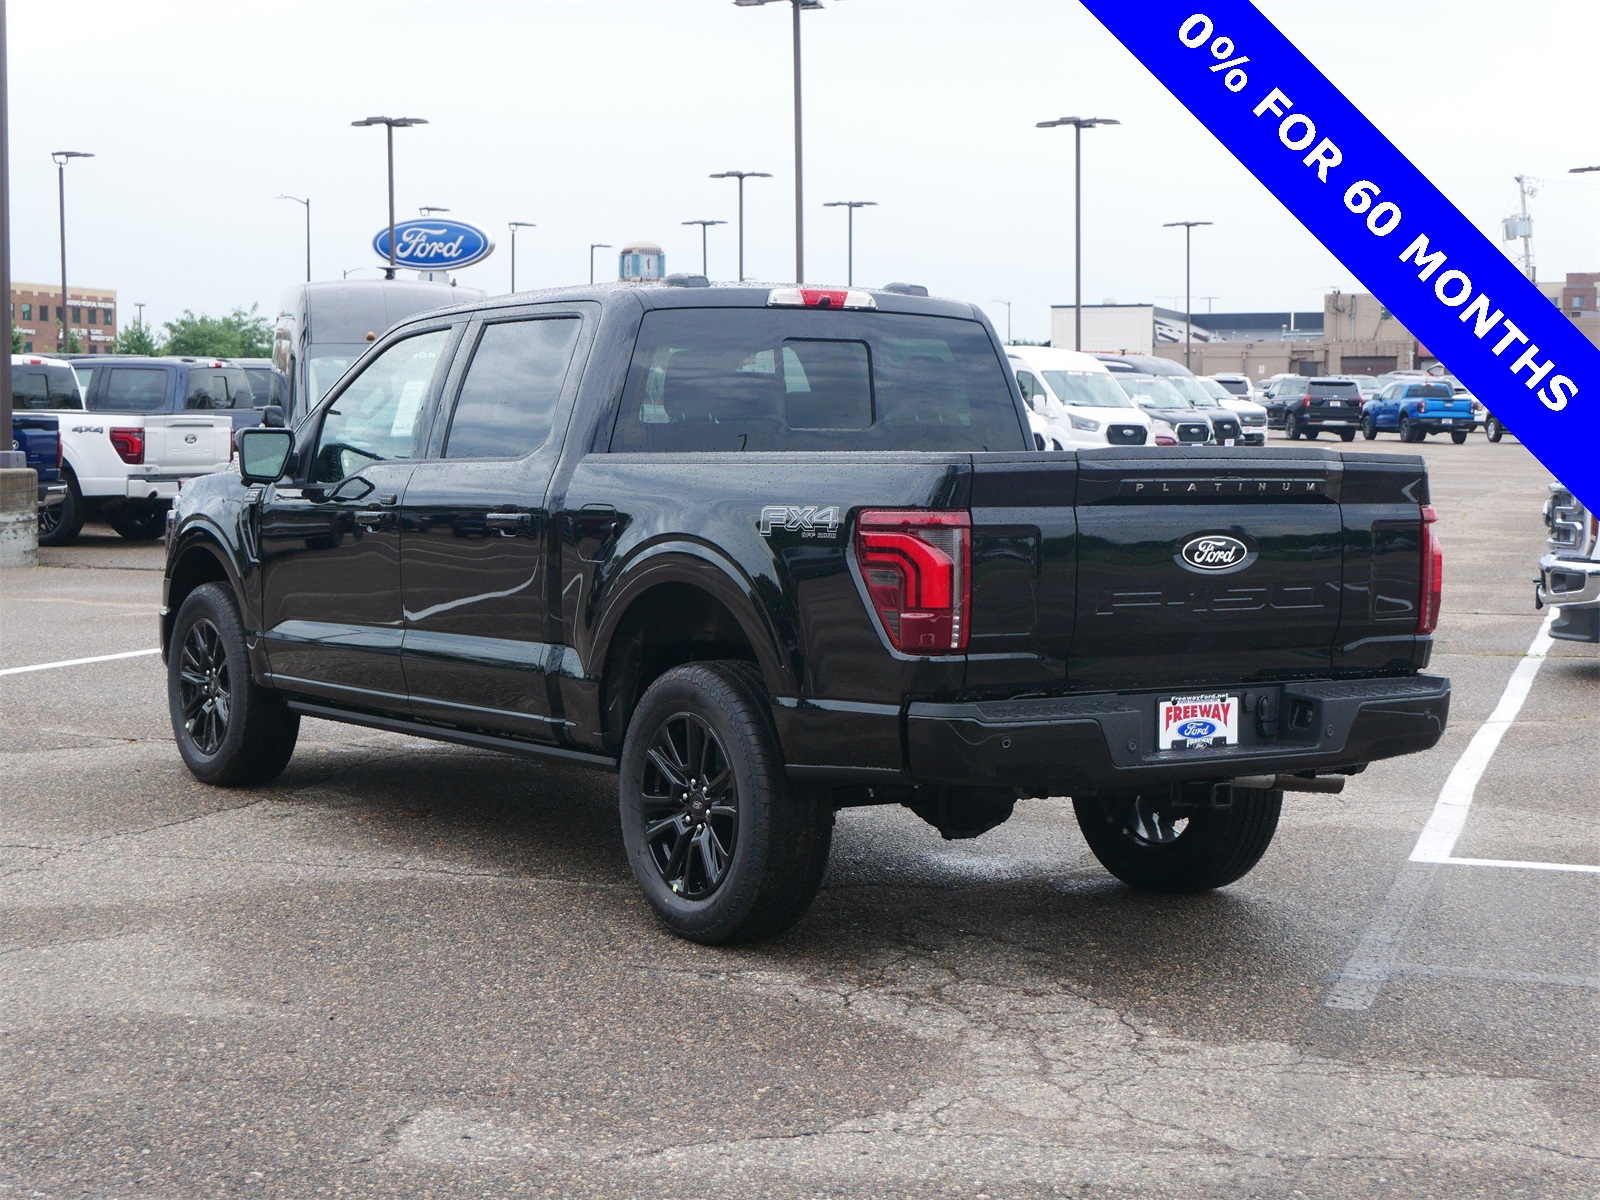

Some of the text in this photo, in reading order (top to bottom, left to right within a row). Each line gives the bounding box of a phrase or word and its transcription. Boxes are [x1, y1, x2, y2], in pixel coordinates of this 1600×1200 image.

[395, 227, 464, 258] Ford
[72, 426, 104, 434] 4X4
[1136, 482, 1315, 493] PLATINUM
[760, 506, 839, 536] FX4
[1194, 540, 1235, 563] Ford
[1171, 693, 1229, 701] FreewayFord.net
[1165, 703, 1231, 732] FREEWAY
[1184, 722, 1209, 736] Ford
